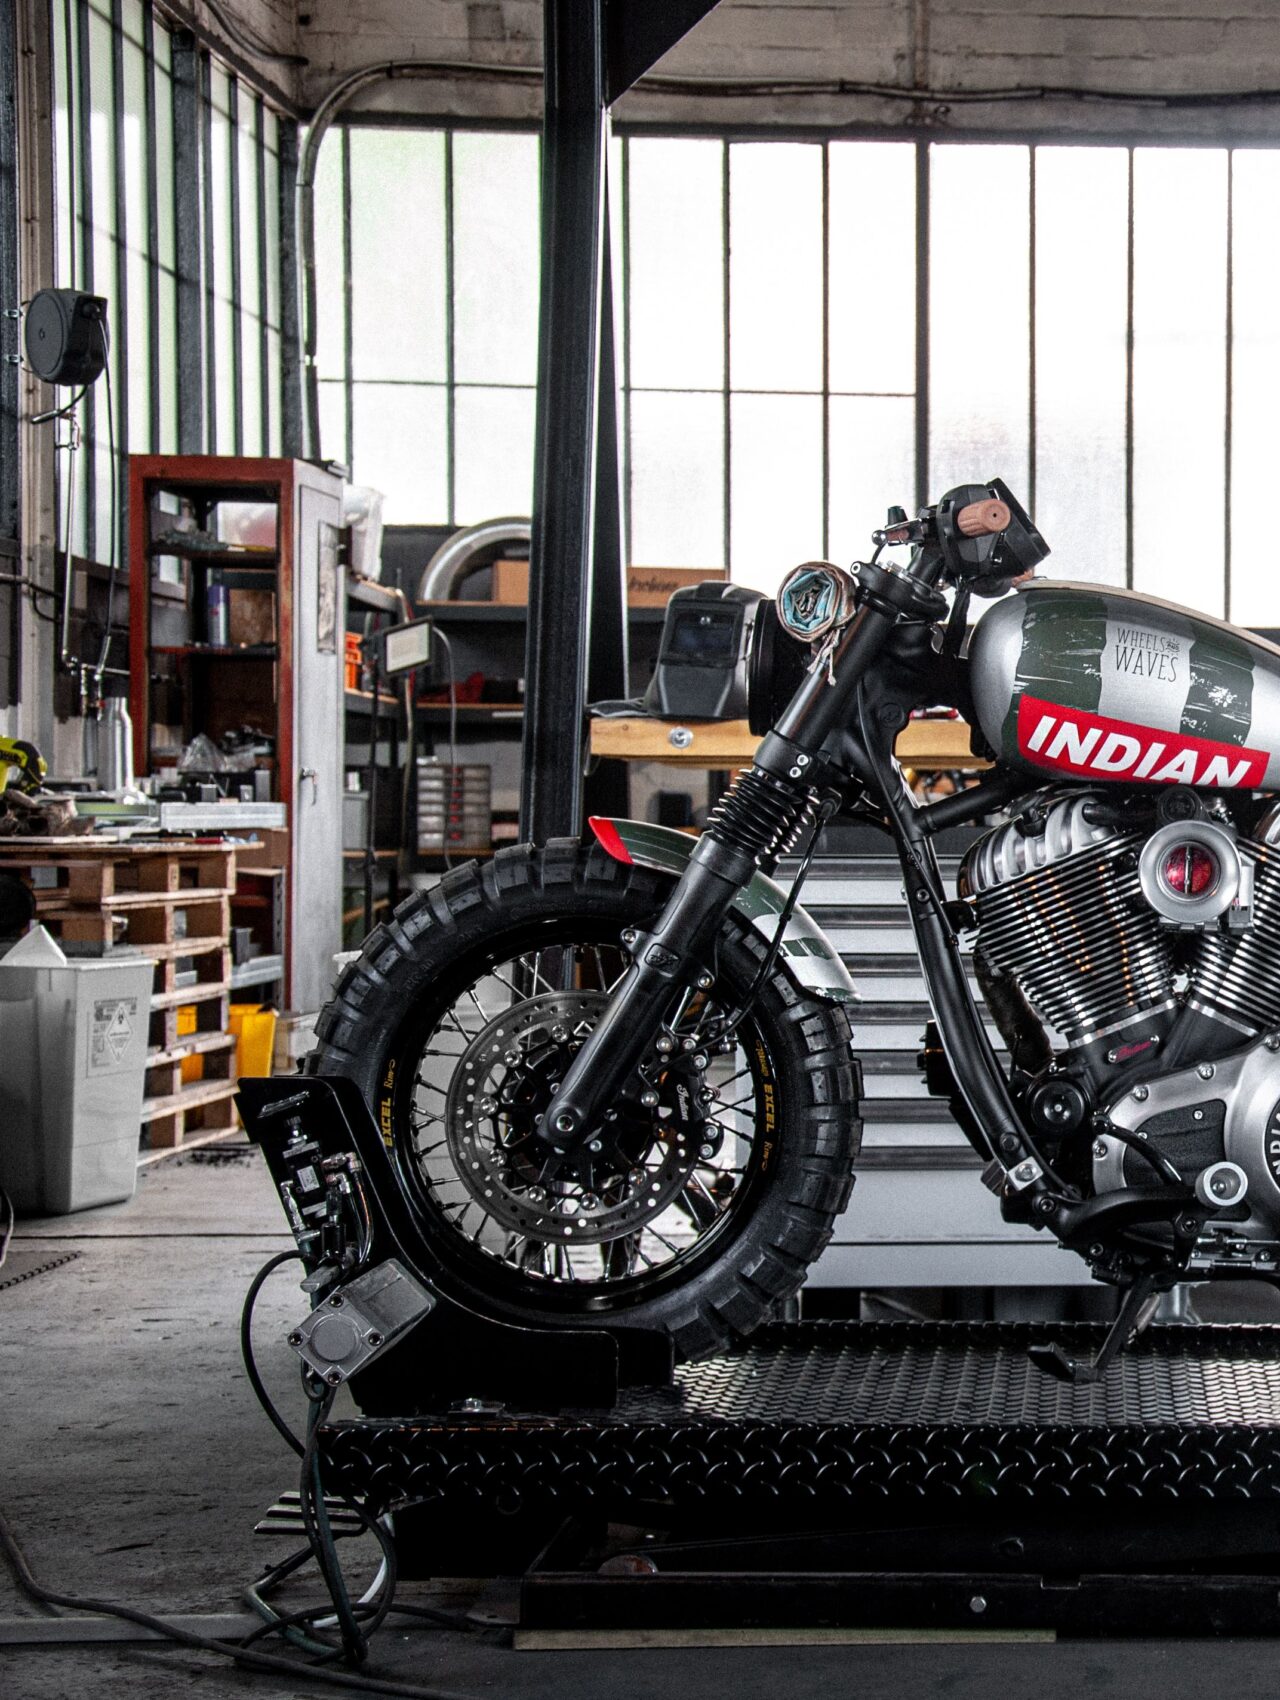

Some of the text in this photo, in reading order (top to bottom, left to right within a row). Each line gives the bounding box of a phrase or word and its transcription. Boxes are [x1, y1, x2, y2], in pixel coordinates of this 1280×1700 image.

[1115, 644, 1178, 682] WAVES
[1117, 627, 1166, 653] WHEELS
[1027, 715, 1252, 787] INDIAN
[381, 1097, 393, 1147] EXCEL
[764, 1083, 775, 1132] EXCEL
